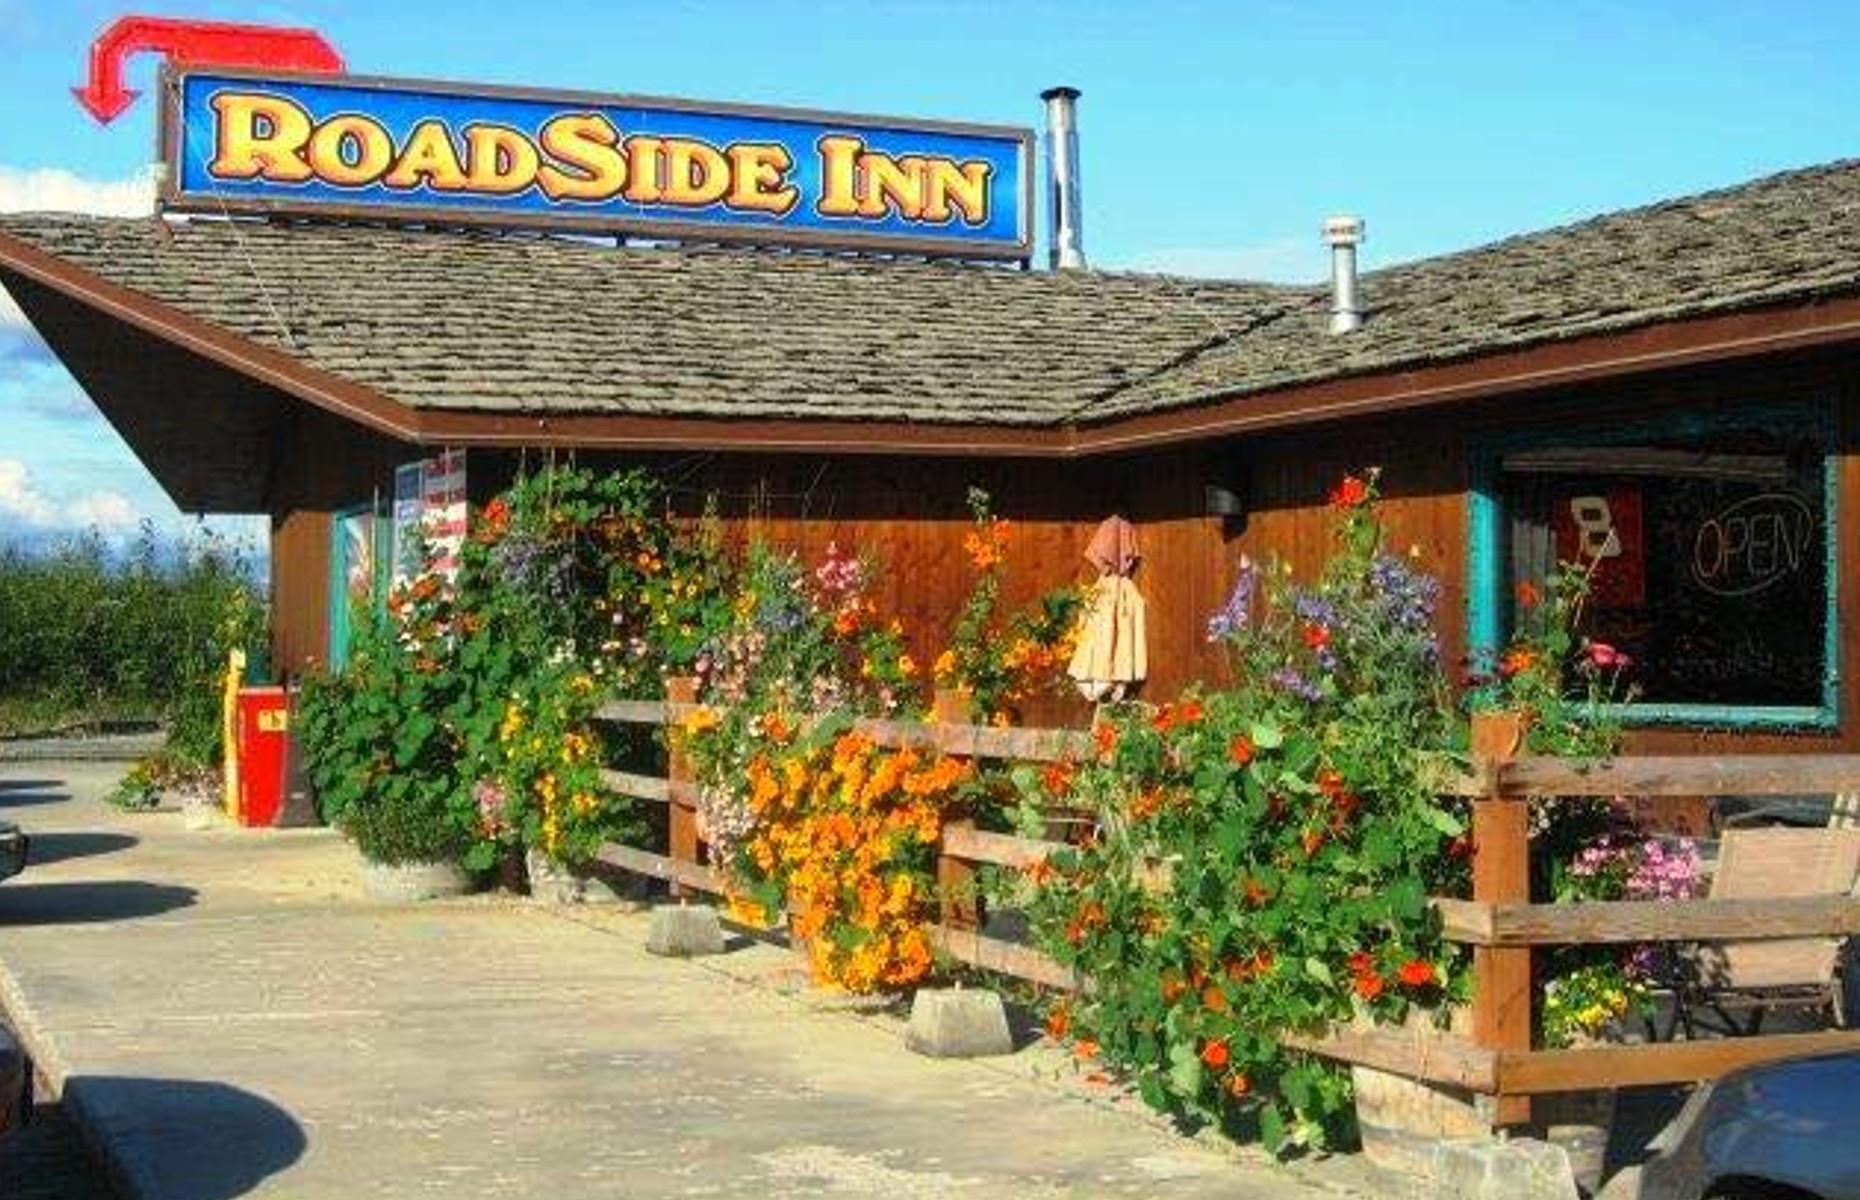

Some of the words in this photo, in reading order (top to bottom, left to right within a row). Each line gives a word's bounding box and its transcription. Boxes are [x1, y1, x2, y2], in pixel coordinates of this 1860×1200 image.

[209, 92, 798, 215] ROADSIDE
[815, 133, 993, 226] INN
[1695, 514, 1803, 578] OPEN
